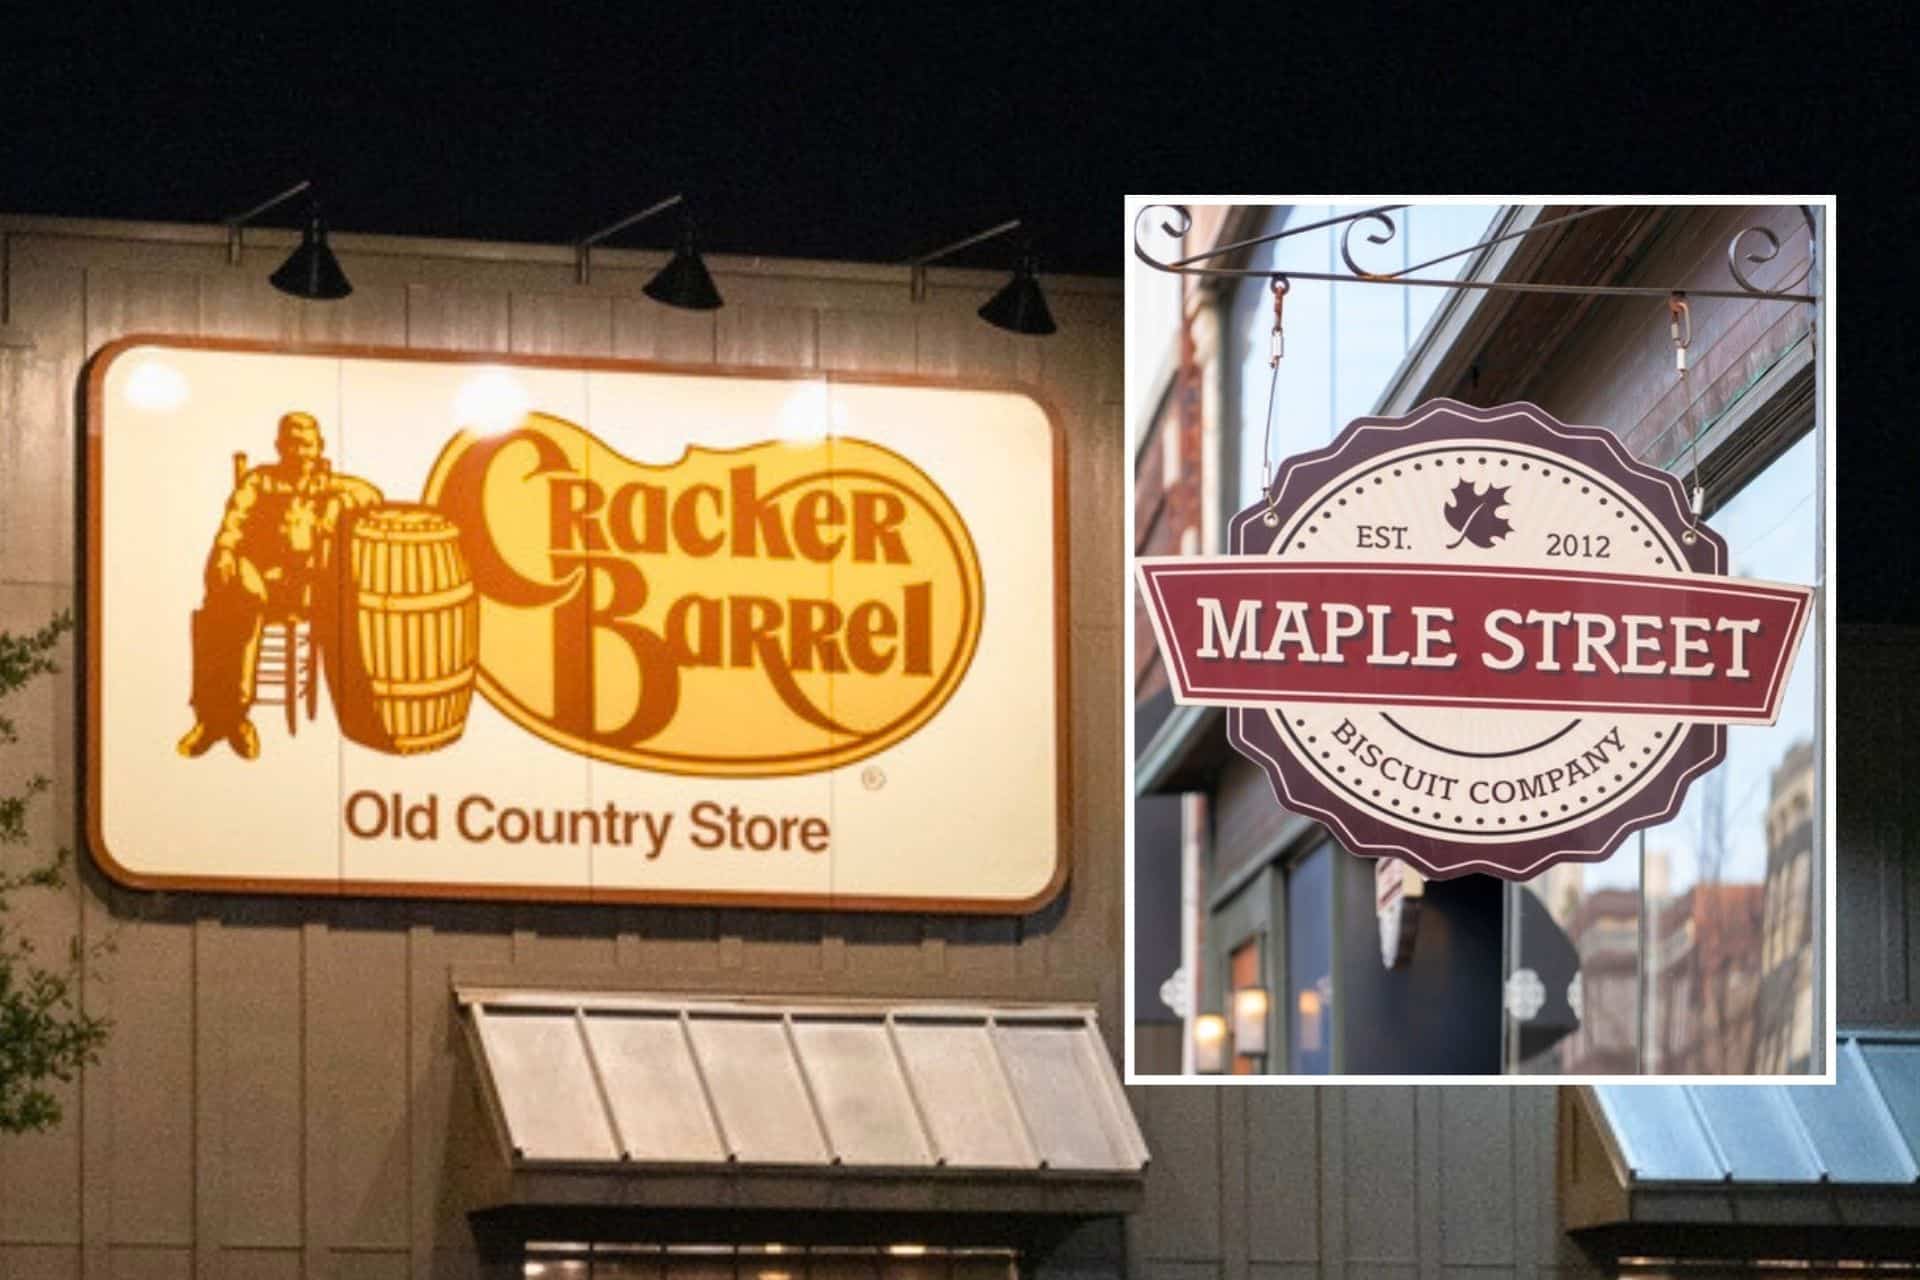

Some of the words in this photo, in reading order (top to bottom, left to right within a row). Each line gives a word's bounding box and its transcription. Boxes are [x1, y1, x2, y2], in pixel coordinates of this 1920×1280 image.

[439, 428, 911, 608] Cracker
[1356, 526, 1412, 550] EST.
[1546, 533, 1611, 558] 2012
[550, 553, 934, 748] Barrel
[1196, 597, 1458, 667] MAPLE
[1481, 608, 1761, 678] STREET
[1331, 717, 1459, 801] BISCUIT
[1469, 726, 1627, 804] COMPANY
[345, 789, 438, 840] Old
[456, 795, 673, 859] Country
[689, 801, 830, 852] Store
